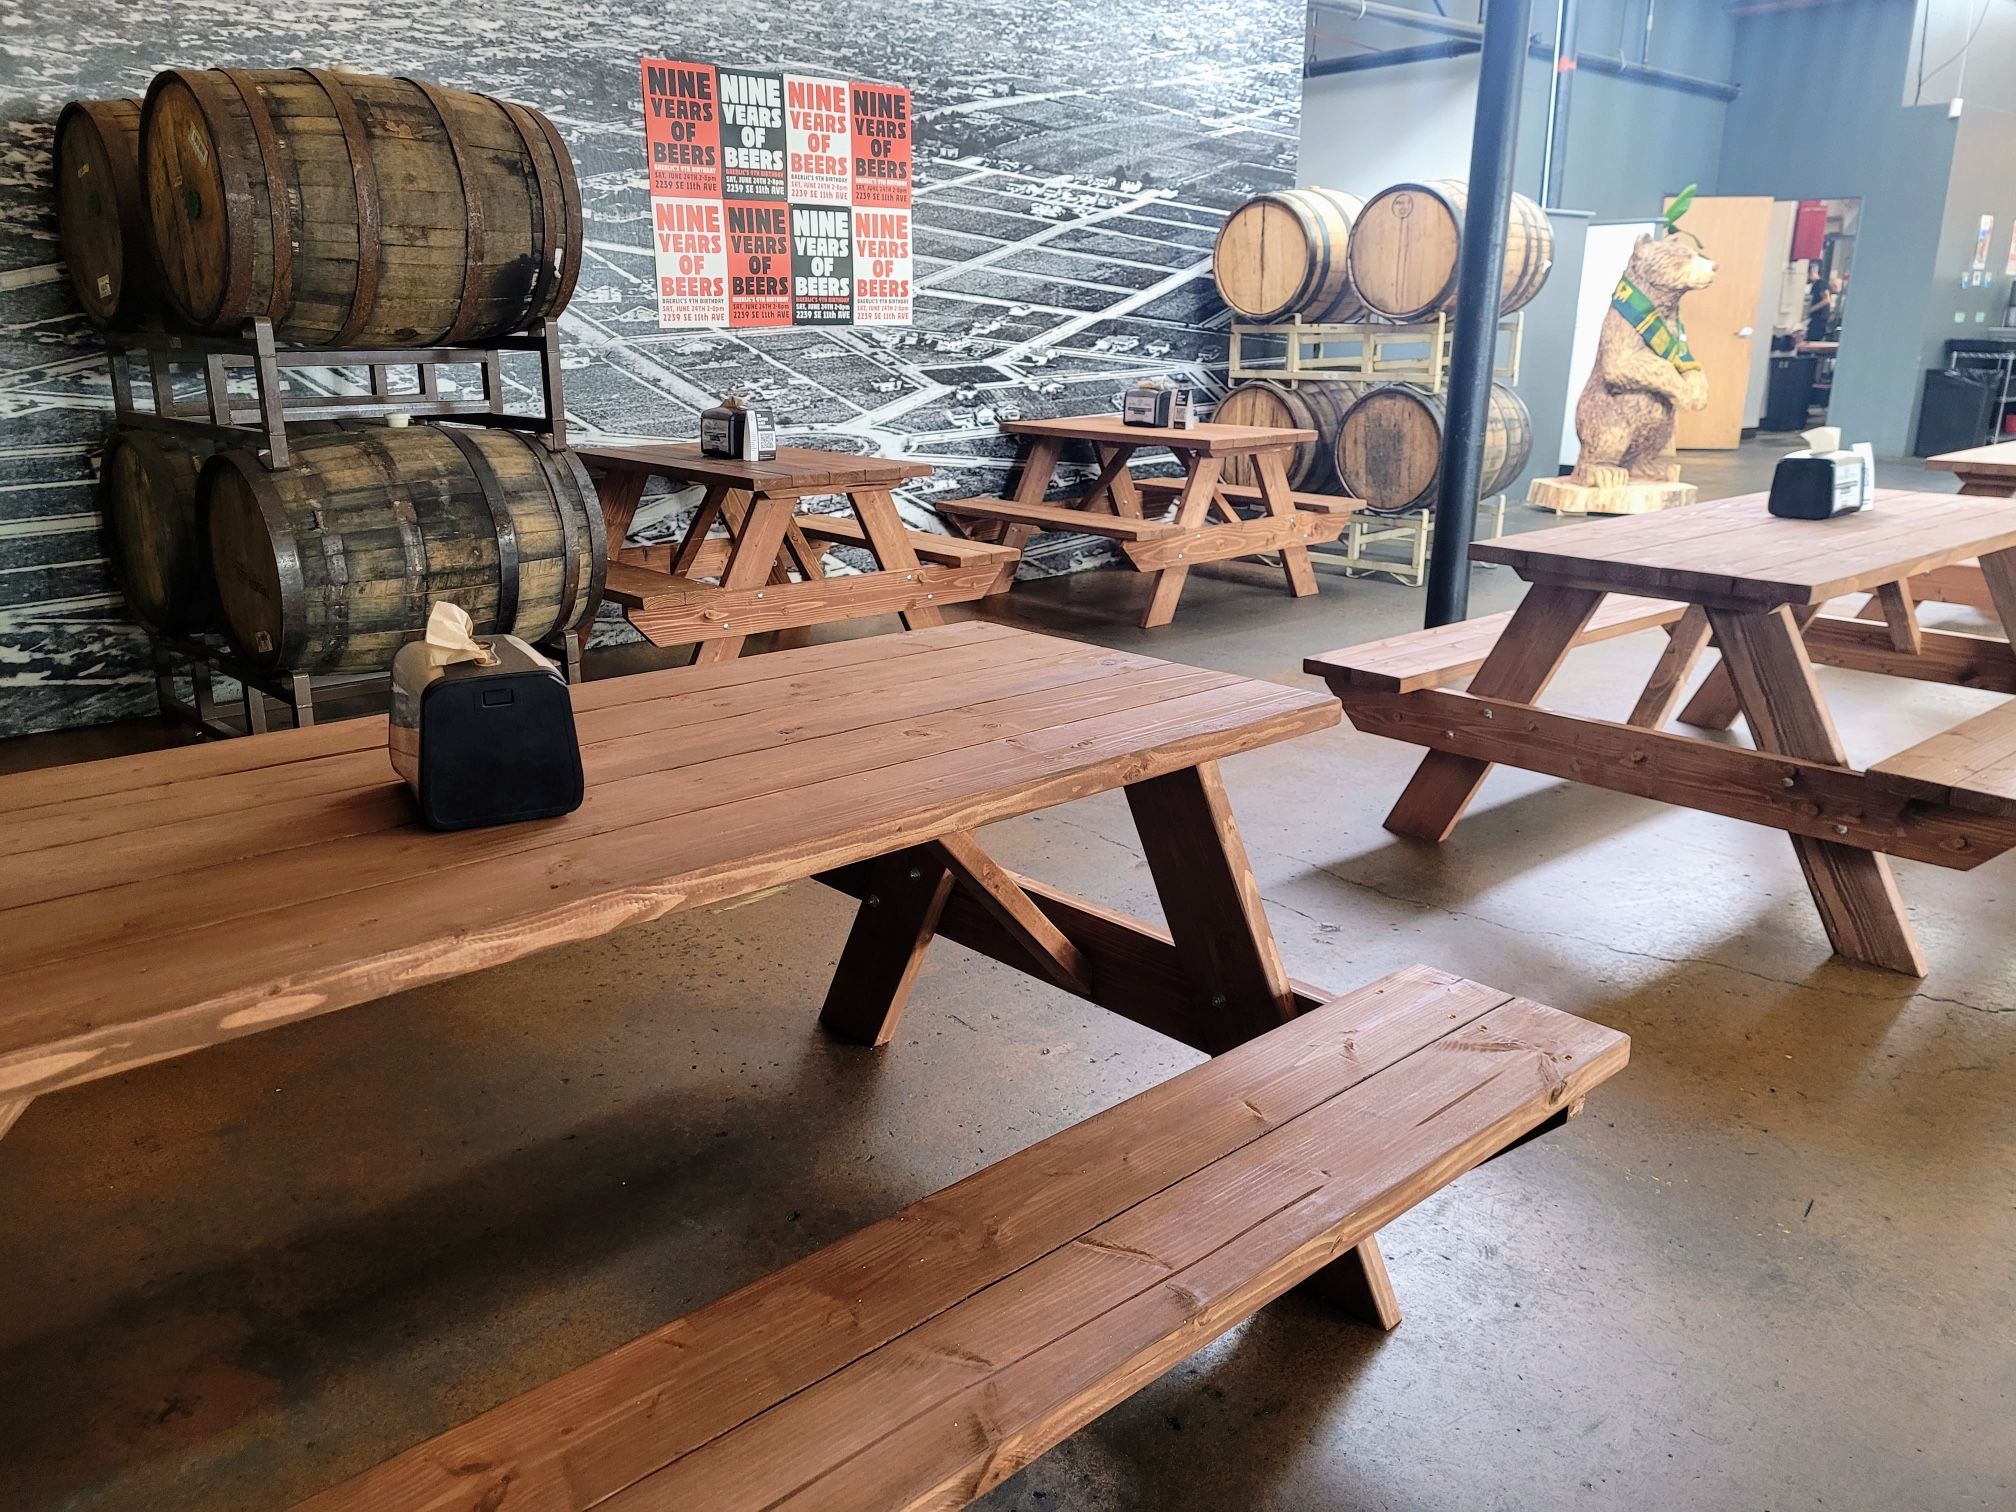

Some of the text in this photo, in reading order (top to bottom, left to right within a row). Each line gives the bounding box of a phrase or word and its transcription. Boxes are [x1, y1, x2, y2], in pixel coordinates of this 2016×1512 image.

[648, 66, 712, 100] NINE
[720, 73, 781, 108] NINE
[788, 81, 846, 113] NINE
[854, 90, 906, 120] NINE
[651, 97, 713, 121] YEARS
[722, 104, 782, 128] YEARS
[671, 121, 696, 142] OF
[790, 111, 847, 133] YEARS
[855, 118, 906, 139] YEARS
[741, 127, 766, 148] OF
[808, 133, 830, 153] OF
[653, 142, 715, 166] BEERS
[724, 147, 784, 171] BEERS
[871, 139, 891, 158] OF
[791, 153, 847, 176] BEERS
[856, 158, 907, 179] BEERS
[655, 180, 717, 192] 2239 SE 11th AVE
[726, 183, 785, 195] 2239 SE 11th AVE
[739, 176, 752, 184] JUNE
[791, 189, 848, 200] 2239 SE 11th AVE
[856, 191, 907, 202] 2239 SE 11th AVE
[656, 203, 720, 232] NINE
[728, 207, 786, 234] NINE
[792, 209, 849, 238] NINE
[855, 213, 908, 239] NINE
[659, 233, 721, 254] YEARS
[731, 235, 787, 254] YEARS
[794, 236, 849, 258] YEARS
[856, 240, 908, 258] YEARS
[679, 255, 704, 275] OF
[749, 256, 771, 275] OF
[811, 257, 834, 277] OF
[872, 260, 894, 278] OF
[661, 276, 723, 297] BEERS
[732, 277, 789, 296] BEERS
[795, 276, 850, 297] BEERS
[857, 279, 909, 298] BEERS
[662, 312, 725, 321] 2239 SE 11th AVE
[733, 310, 790, 319] 2239 SE 11th AVE
[796, 310, 850, 319] 2239 SE 11th AVE
[857, 312, 909, 320] 2239 SE 11th AVE
